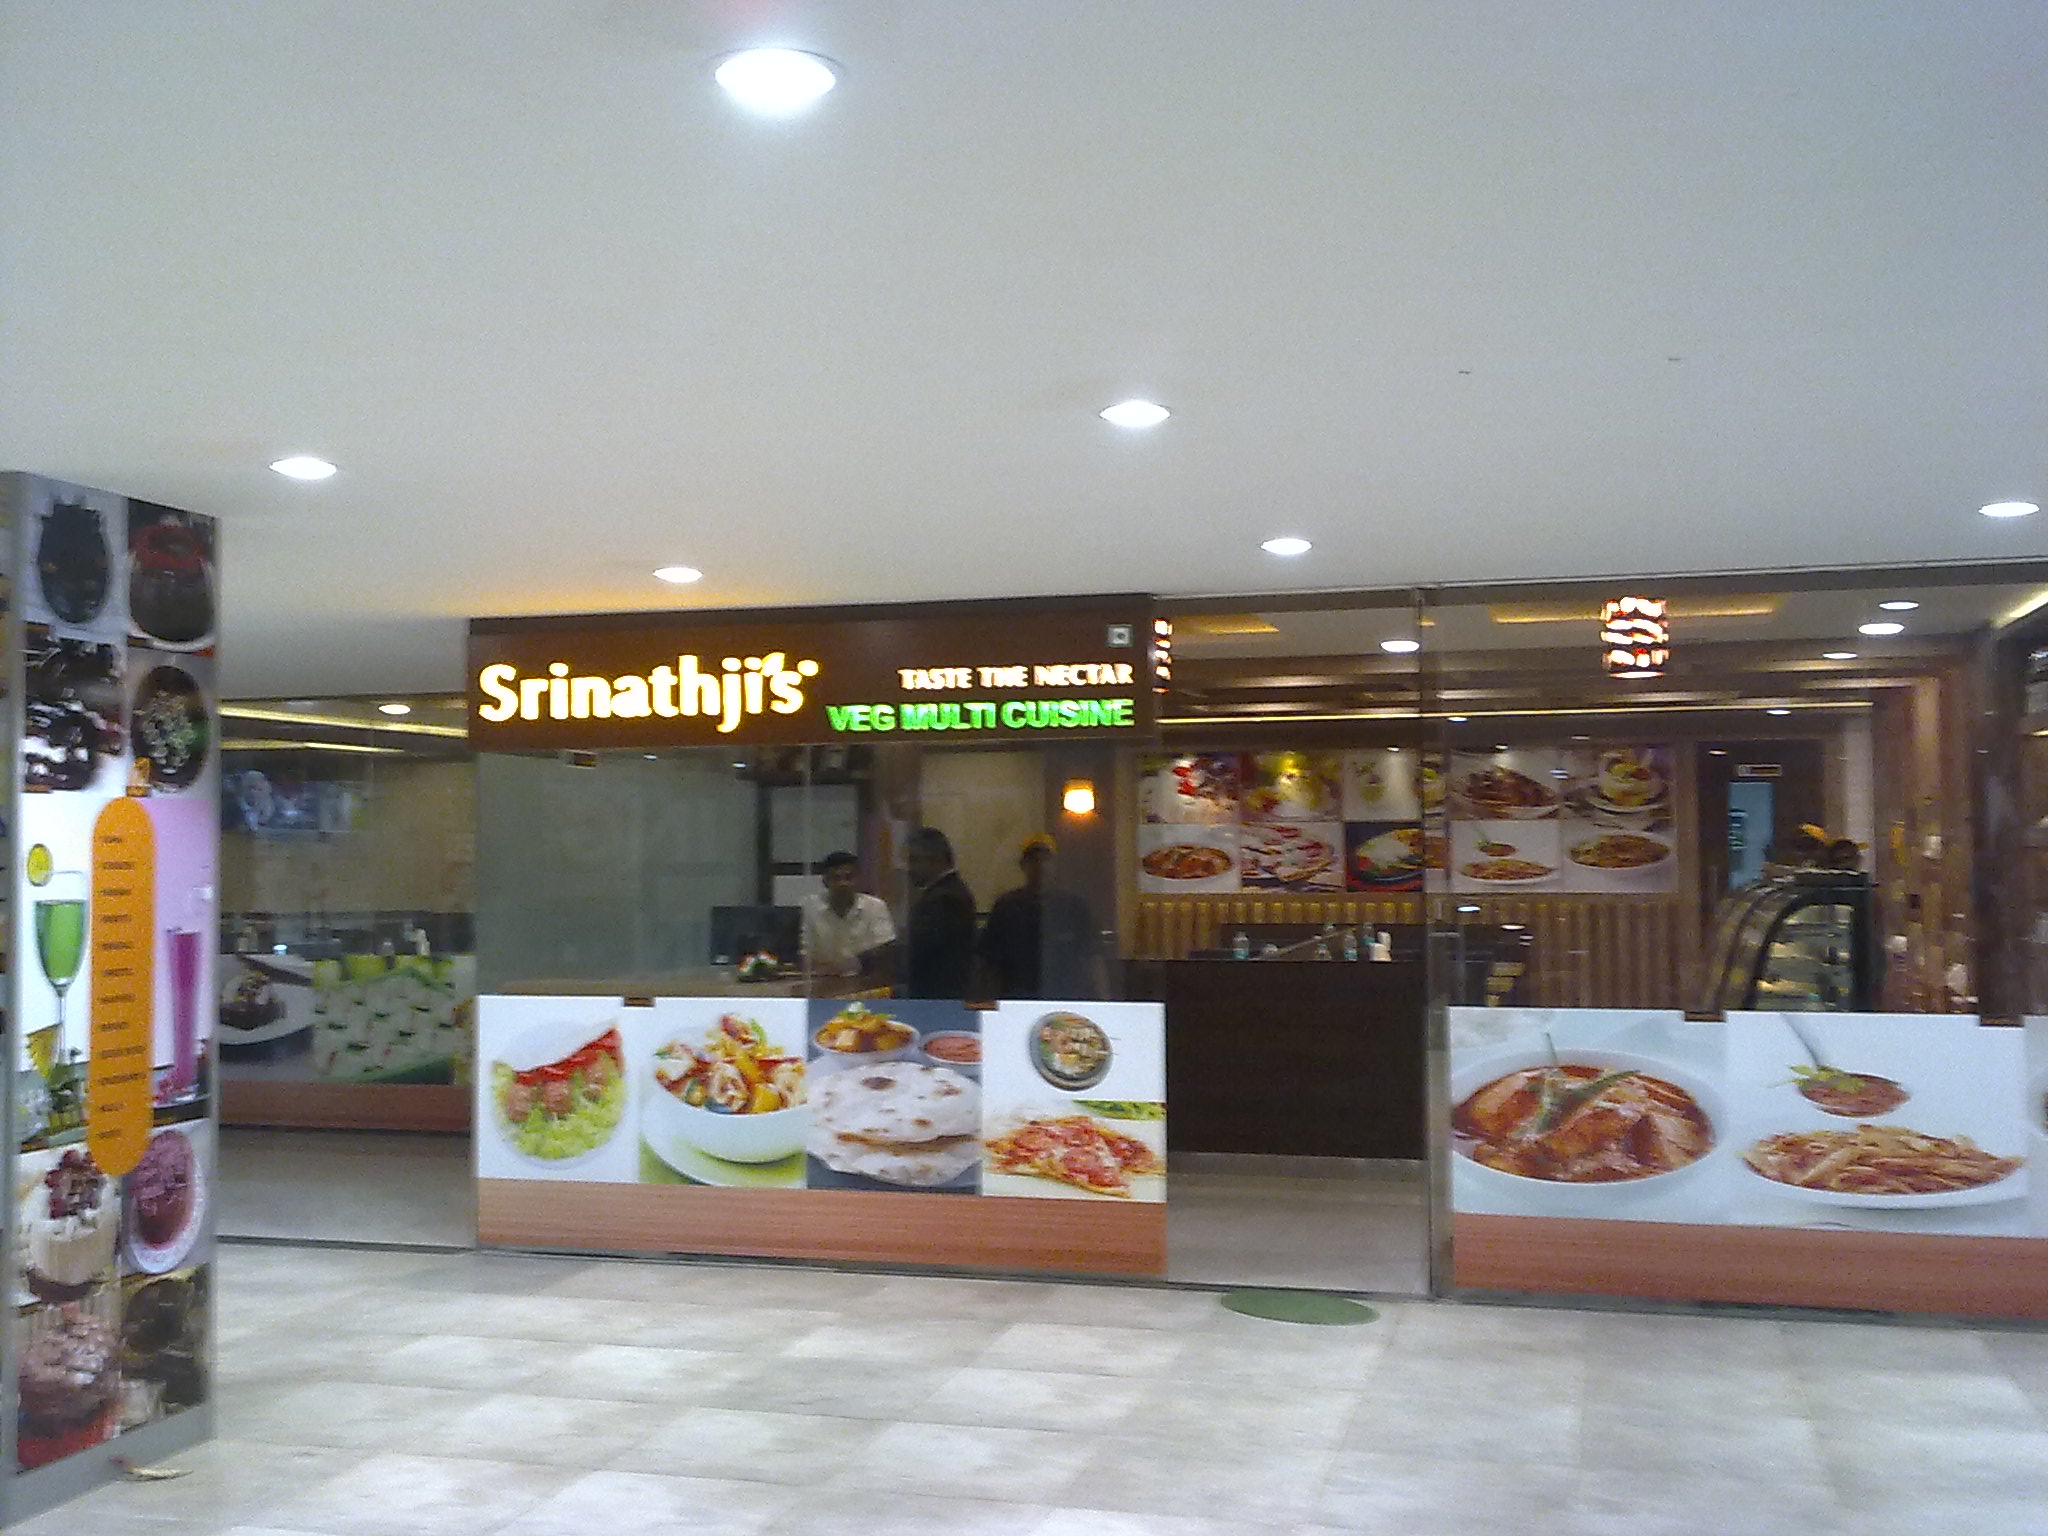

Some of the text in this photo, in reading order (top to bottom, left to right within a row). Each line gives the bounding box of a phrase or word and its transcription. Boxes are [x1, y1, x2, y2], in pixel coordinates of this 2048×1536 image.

[478, 652, 804, 734] Srinathji's
[897, 663, 1134, 690] TASTE THE NECTAR
[826, 698, 1136, 732] VEG MULTI CUISINE
